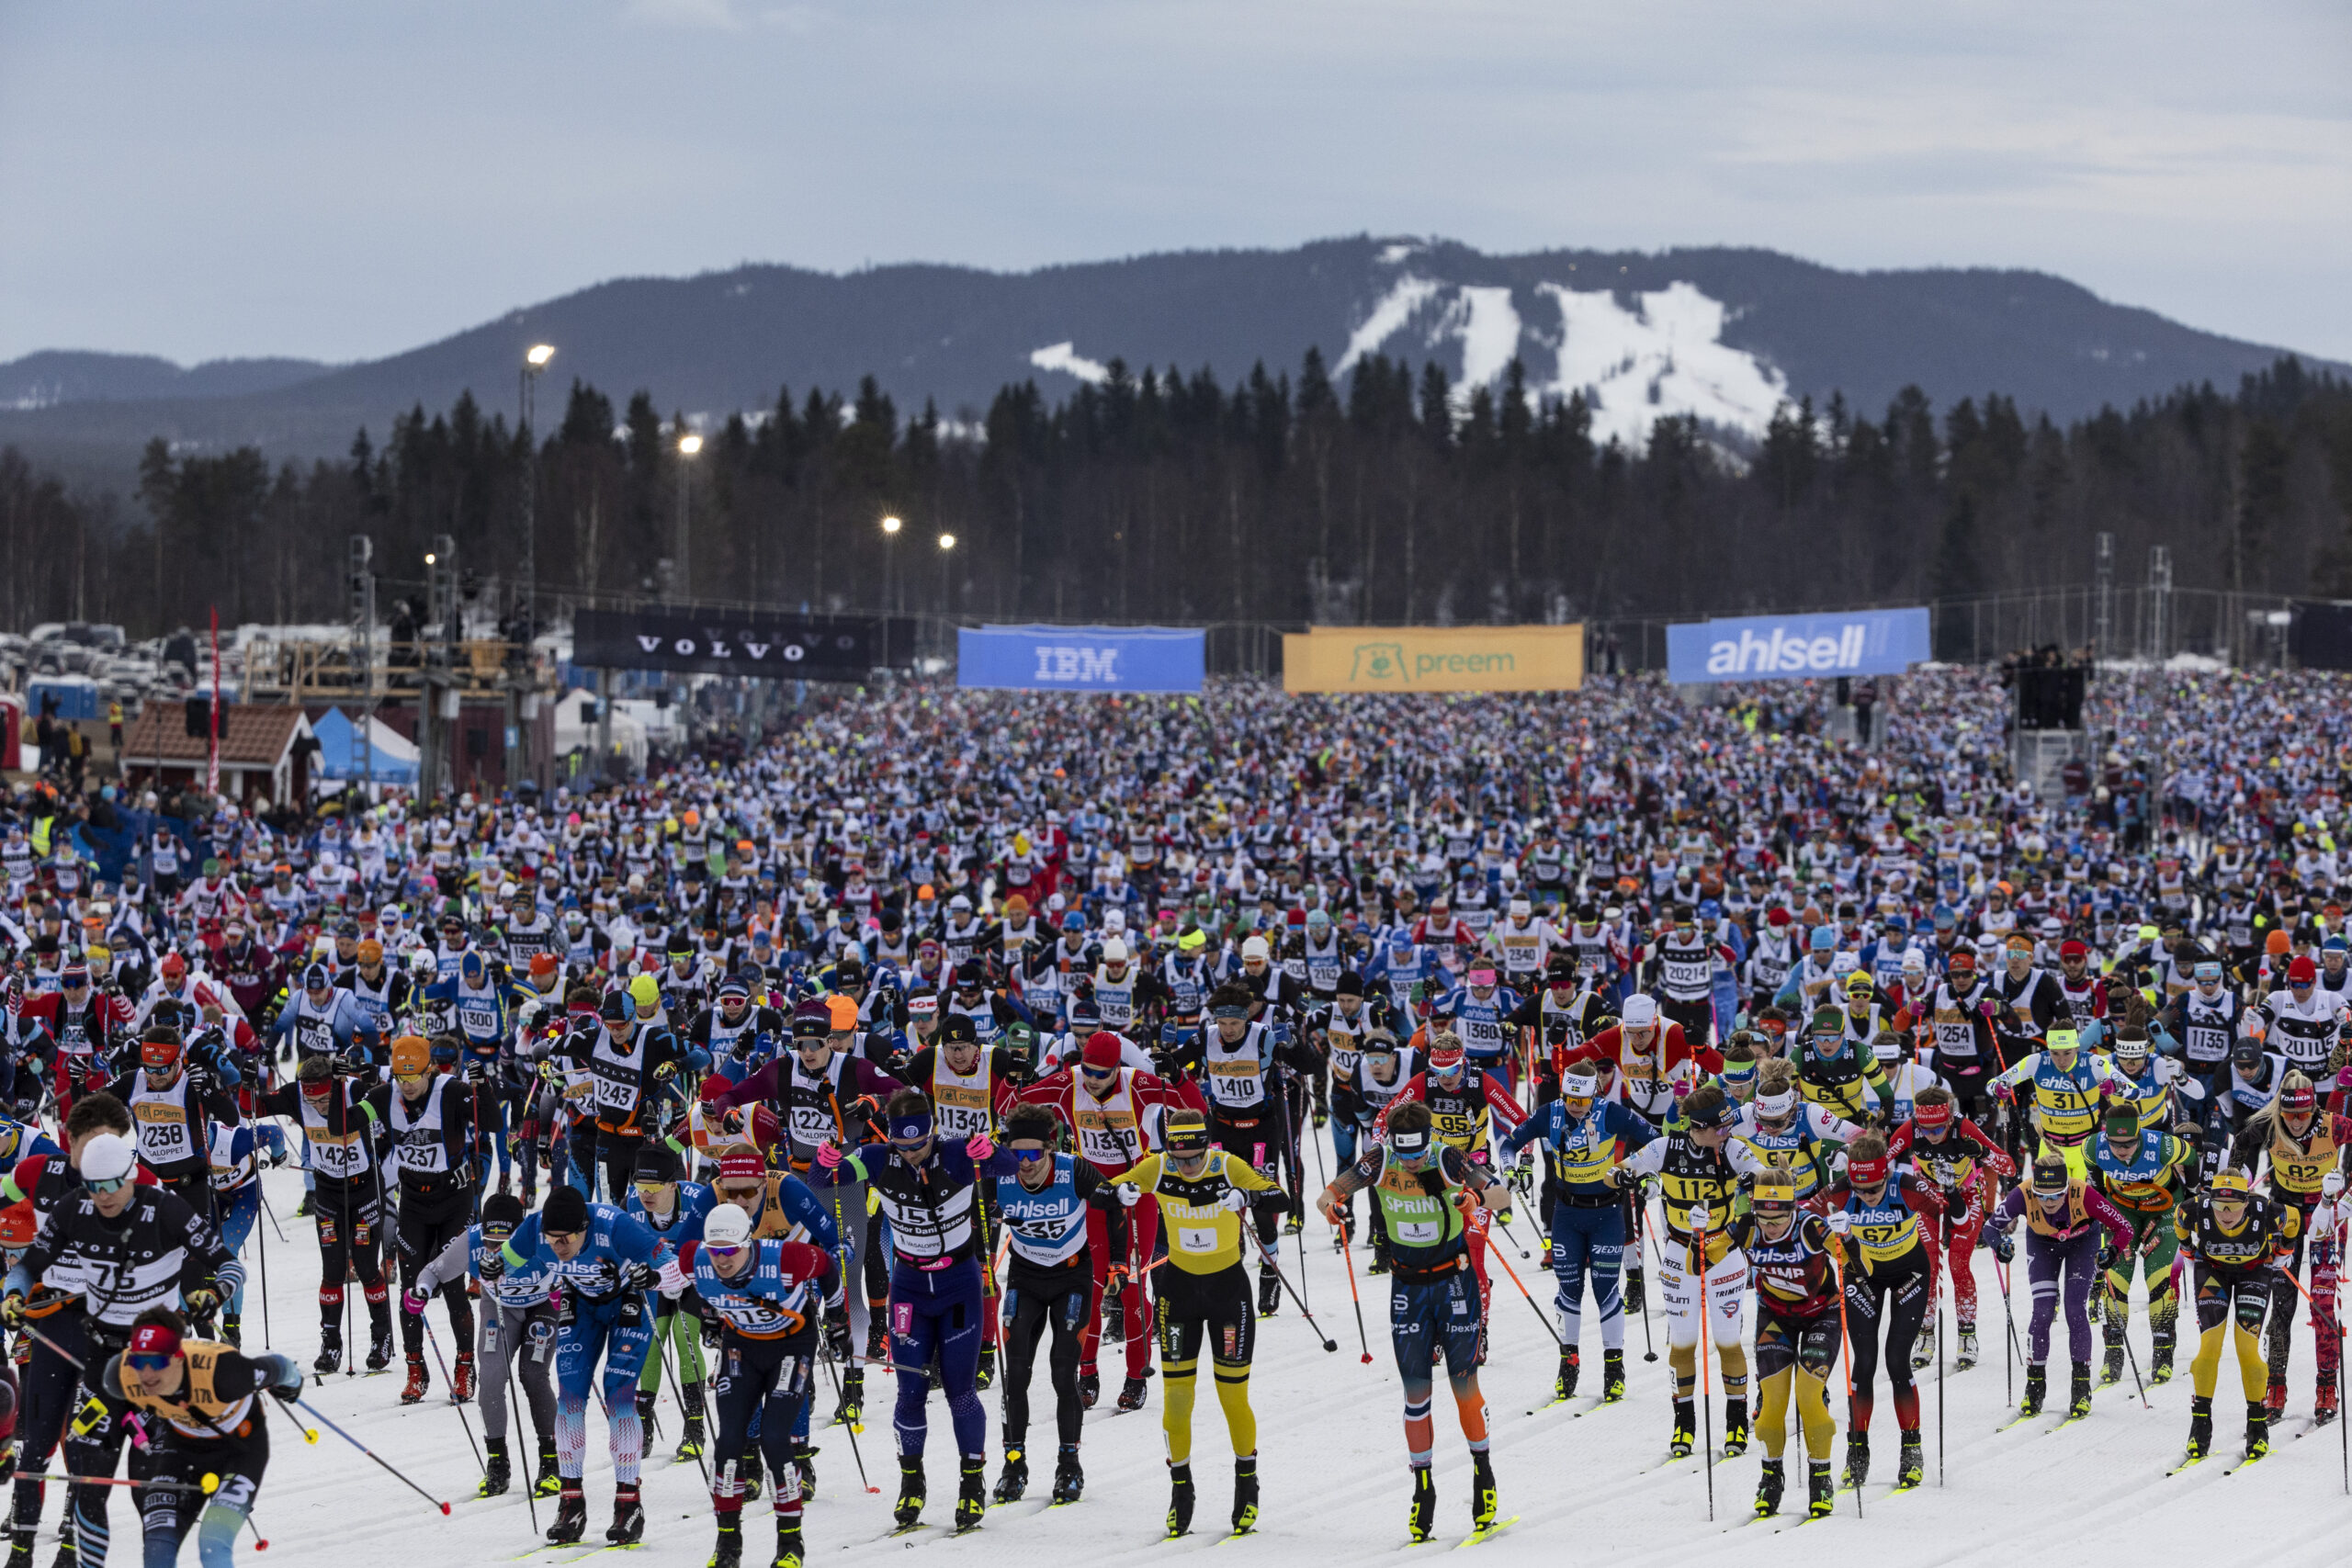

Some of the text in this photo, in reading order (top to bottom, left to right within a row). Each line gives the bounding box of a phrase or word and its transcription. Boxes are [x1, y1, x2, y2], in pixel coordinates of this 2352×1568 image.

[638, 635, 805, 662] VOLVO
[1706, 626, 1866, 674] ahlsell
[1035, 645, 1118, 682] IBM
[1416, 649, 1515, 681] preem
[1510, 953, 1536, 961] 2340
[1669, 965, 1706, 981] 20214
[1103, 1005, 1130, 1017] 1348
[463, 1011, 492, 1028] 1300
[1465, 1021, 1498, 1038] 1380
[1939, 1025, 1970, 1043] 1254
[2192, 1030, 2224, 1049] 1135
[2284, 1037, 2334, 1056] 20105
[1804, 1050, 1815, 1062] 64
[1843, 1048, 1854, 1059] 64
[596, 1064, 636, 1080] VOLVO
[1217, 1077, 1255, 1096] 1410
[1427, 1077, 1438, 1088] 85
[1468, 1077, 1479, 1088] 85
[2041, 1077, 2087, 1089] ahlsell
[597, 1078, 633, 1108] 1243
[959, 1092, 985, 1103] preem
[2053, 1093, 2075, 1109] 31
[1488, 1089, 1521, 1121] Internorm
[1764, 1102, 1786, 1111] VLTAVA
[791, 1109, 831, 1131] 122
[939, 1106, 989, 1133] 11342
[1441, 1116, 1469, 1131] 85
[1552, 1115, 1561, 1129] 27
[141, 1124, 184, 1148] 1238
[795, 1129, 838, 1140] VASALOPPET
[1083, 1129, 1136, 1150] 11350
[2317, 1126, 2328, 1139] 82
[1668, 1138, 1685, 1151] 112
[317, 1145, 359, 1162] 1426
[397, 1146, 438, 1168] 1237
[2098, 1150, 2110, 1160] 43
[2144, 1150, 2155, 1161] 43
[1054, 1169, 1070, 1184] 235
[1568, 1168, 1600, 1182] VASALOPPET
[2203, 1170, 2213, 1180] 36
[2288, 1165, 2318, 1179] 82
[884, 1186, 949, 1202] VOLO
[1164, 1181, 1225, 1193] VOLVO
[1678, 1179, 1717, 1201] 112
[78, 1199, 94, 1215] 76
[140, 1204, 156, 1222] 76
[358, 1199, 379, 1214] TRIMTE
[596, 1208, 615, 1221] 159
[1003, 1198, 1069, 1218] ahlsell
[1167, 1201, 1222, 1220] CHAMP
[1849, 1209, 1903, 1224] ahlsell
[2030, 1210, 2041, 1223] 14
[2072, 1209, 2082, 1221] 14
[2204, 1218, 2211, 1230] 9
[2253, 1219, 2260, 1232] 9
[594, 1234, 610, 1247] 159
[1862, 1227, 1894, 1243] 67
[1867, 1246, 1904, 1258] VASALOPPET
[546, 1259, 602, 1274] ahlse
[760, 1265, 777, 1279] 119
[1663, 1258, 1683, 1270] PETZL
[696, 1265, 714, 1280] 119
[1712, 1269, 1746, 1287] BAUHAUS
[1715, 1283, 1745, 1299] TRIMTEX
[1898, 1285, 1922, 1305] TRIMTEX
[1850, 1297, 1872, 1319] CHARGE
[1855, 1292, 1876, 1316] RAGDE
[1159, 1295, 1169, 1352] engcon
[1237, 1300, 1247, 1360] SWEDEMOUNT
[381, 1333, 390, 1360] alpina
[191, 1353, 211, 1370] 178
[193, 1387, 214, 1404] 178
